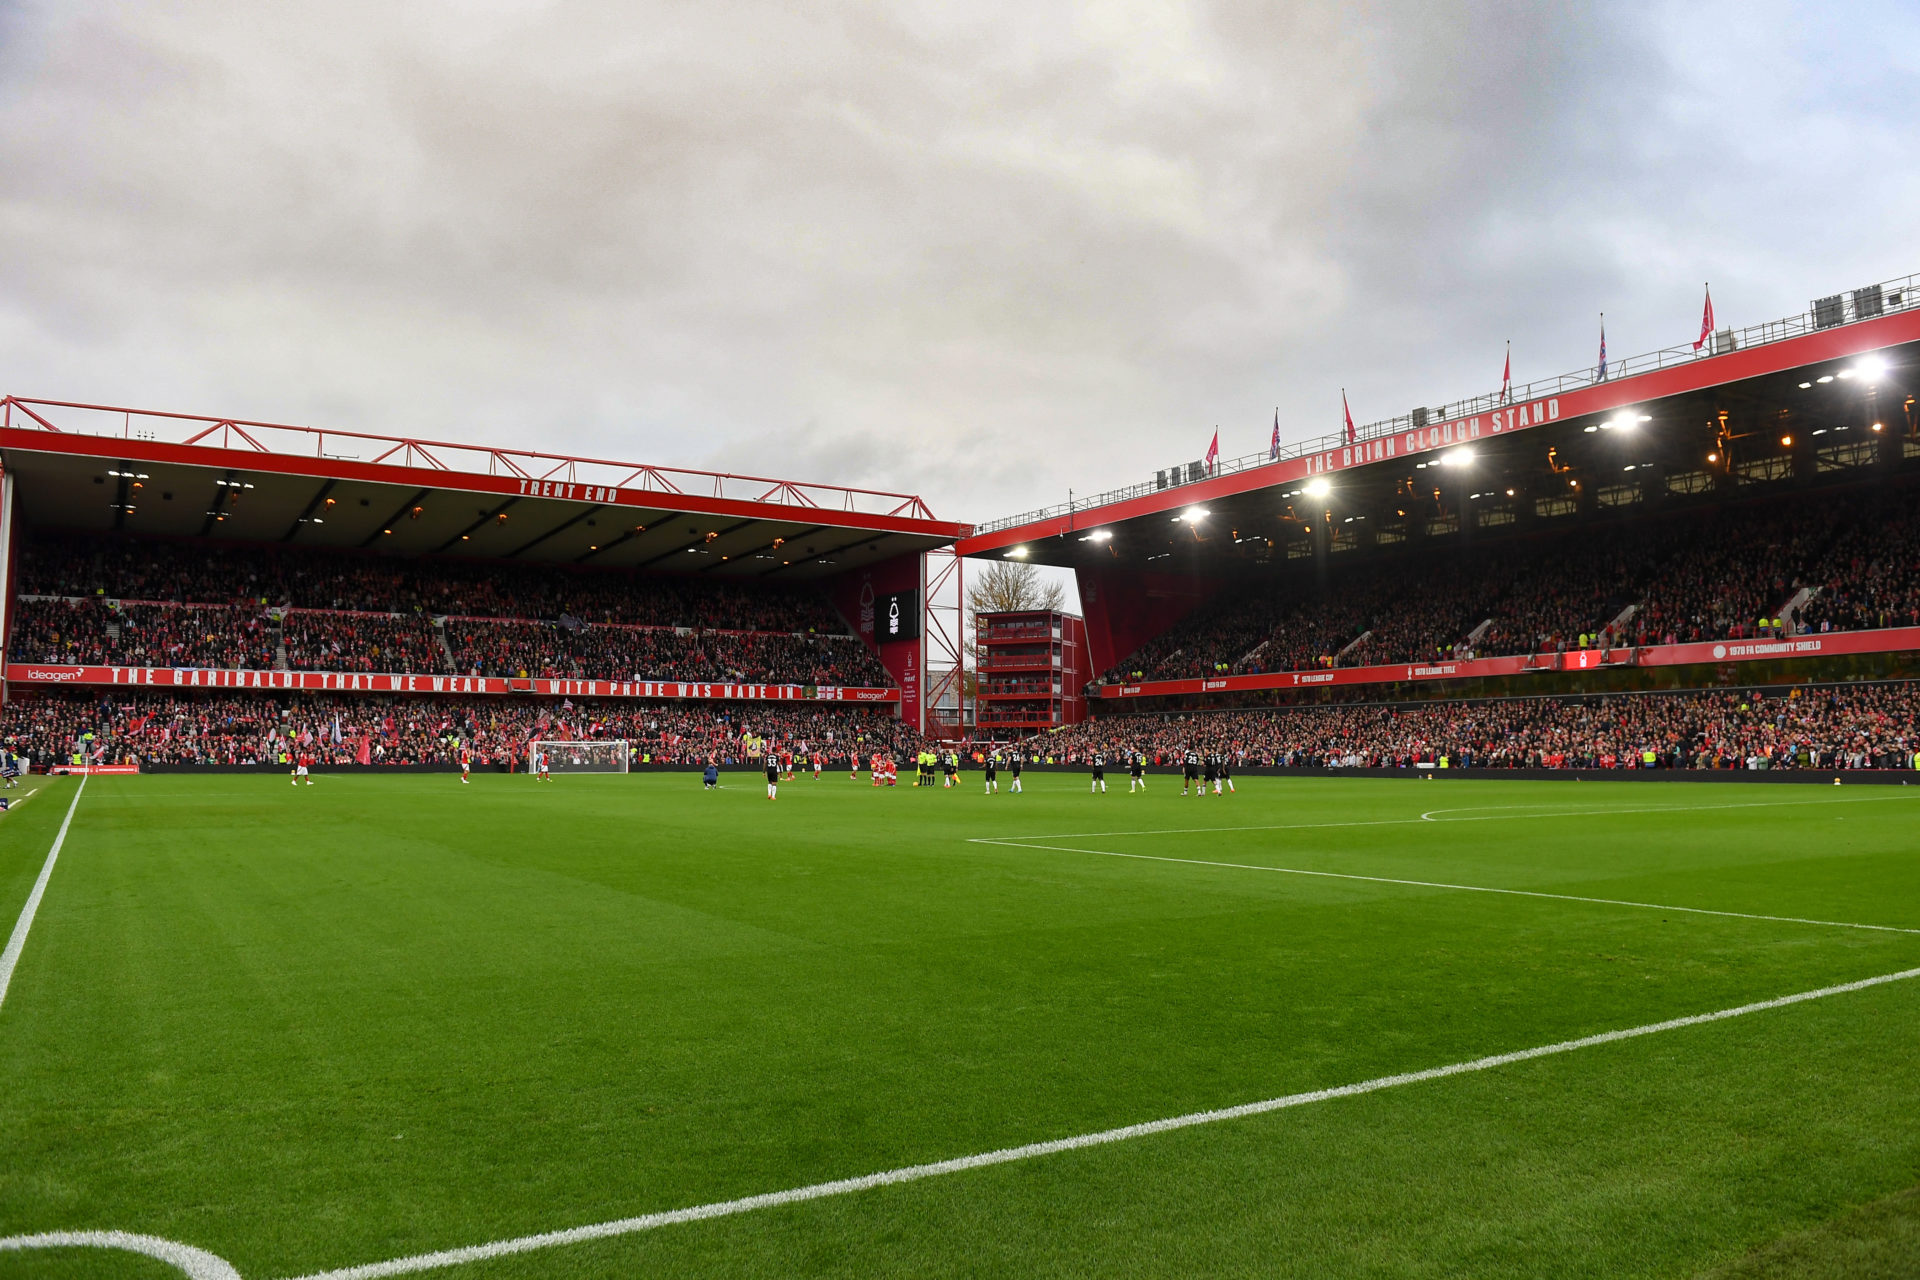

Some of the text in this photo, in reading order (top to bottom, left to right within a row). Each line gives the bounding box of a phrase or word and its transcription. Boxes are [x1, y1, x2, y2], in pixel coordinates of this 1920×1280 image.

[1305, 398, 1559, 475] THE BRIAN CLOUGH STAND
[520, 480, 617, 503] TRENT END
[1729, 640, 1821, 656] 1978 FA COMMUNITY SHIELD
[28, 669, 75, 681] Ideagen
[112, 668, 154, 684] THE
[174, 670, 304, 688] GARIBALDI
[322, 674, 373, 689] THAT
[391, 676, 416, 691] WE
[433, 677, 486, 692] WEAR
[550, 680, 596, 695] WITH
[610, 681, 664, 696] PRIDE
[678, 684, 711, 698] WAS
[724, 685, 766, 698] MADE
[778, 686, 793, 699] IN
[856, 691, 885, 701] Ideagen
[767, 758, 777, 767] 33
[1188, 755, 1197, 764] 25
